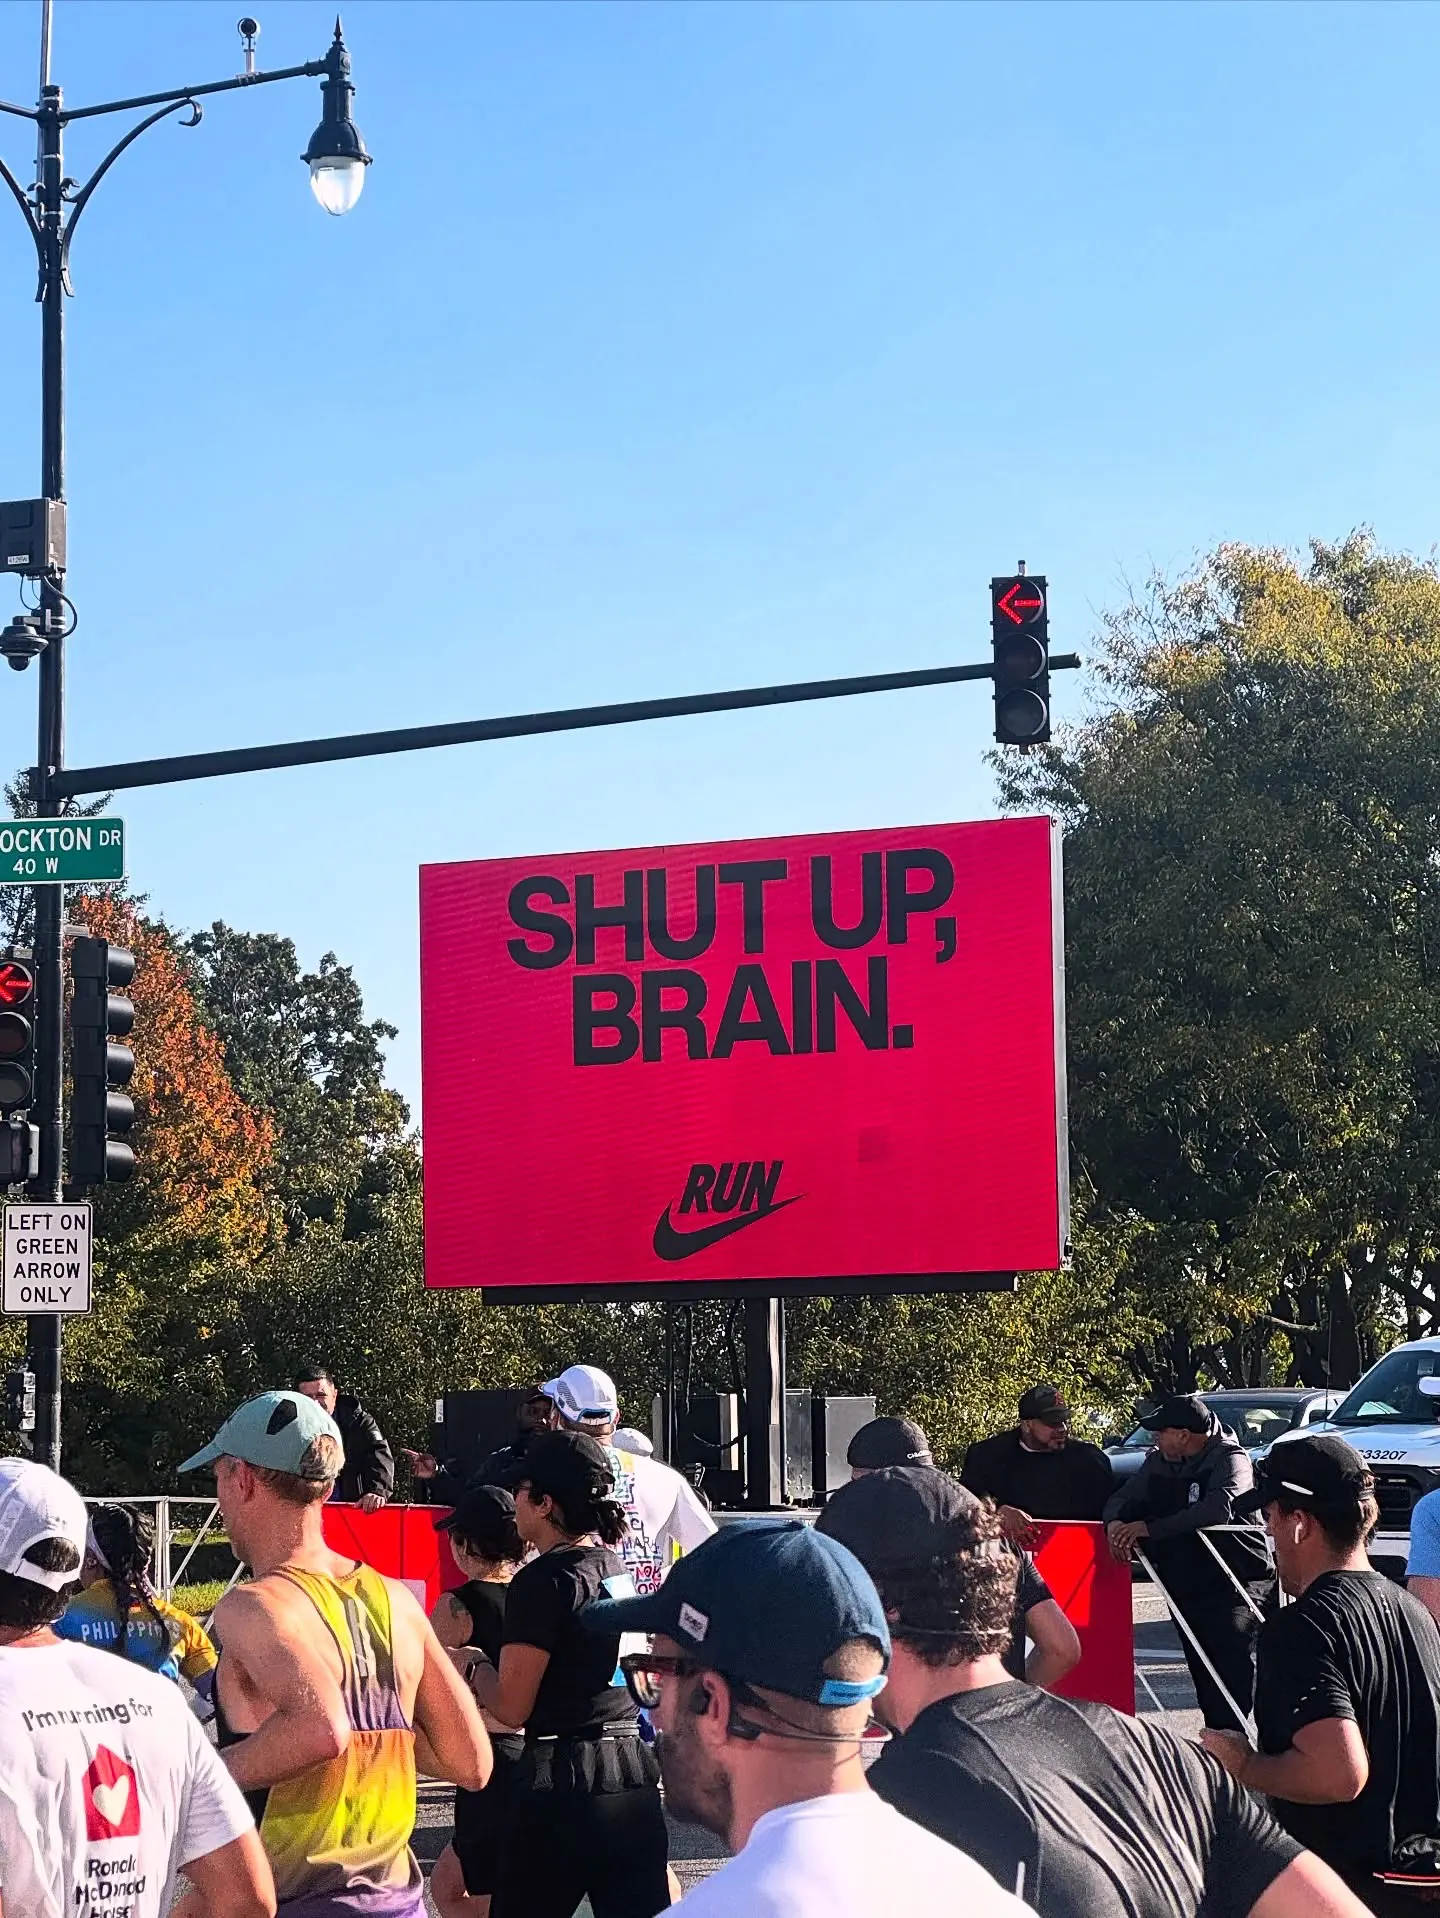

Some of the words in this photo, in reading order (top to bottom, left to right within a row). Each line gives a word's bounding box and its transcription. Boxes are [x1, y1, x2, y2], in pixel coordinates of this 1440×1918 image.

[99, 829, 121, 846] DR
[13, 858, 37, 875] 40
[45, 857, 59, 874] W
[507, 859, 788, 970] SHUT
[811, 848, 957, 964] UP,
[572, 955, 914, 1066] BRAIN.
[678, 1161, 784, 1213] RUN
[8, 1214, 53, 1230] LEFT
[60, 1214, 86, 1231] ON
[16, 1238, 78, 1254] GREEN
[13, 1262, 80, 1279] ARROW
[20, 1286, 72, 1303] ONLY
[22, 1710, 58, 1731] I'm
[57, 1703, 131, 1724] running
[129, 1697, 153, 1717] for
[75, 1875, 146, 1904] McDonad
